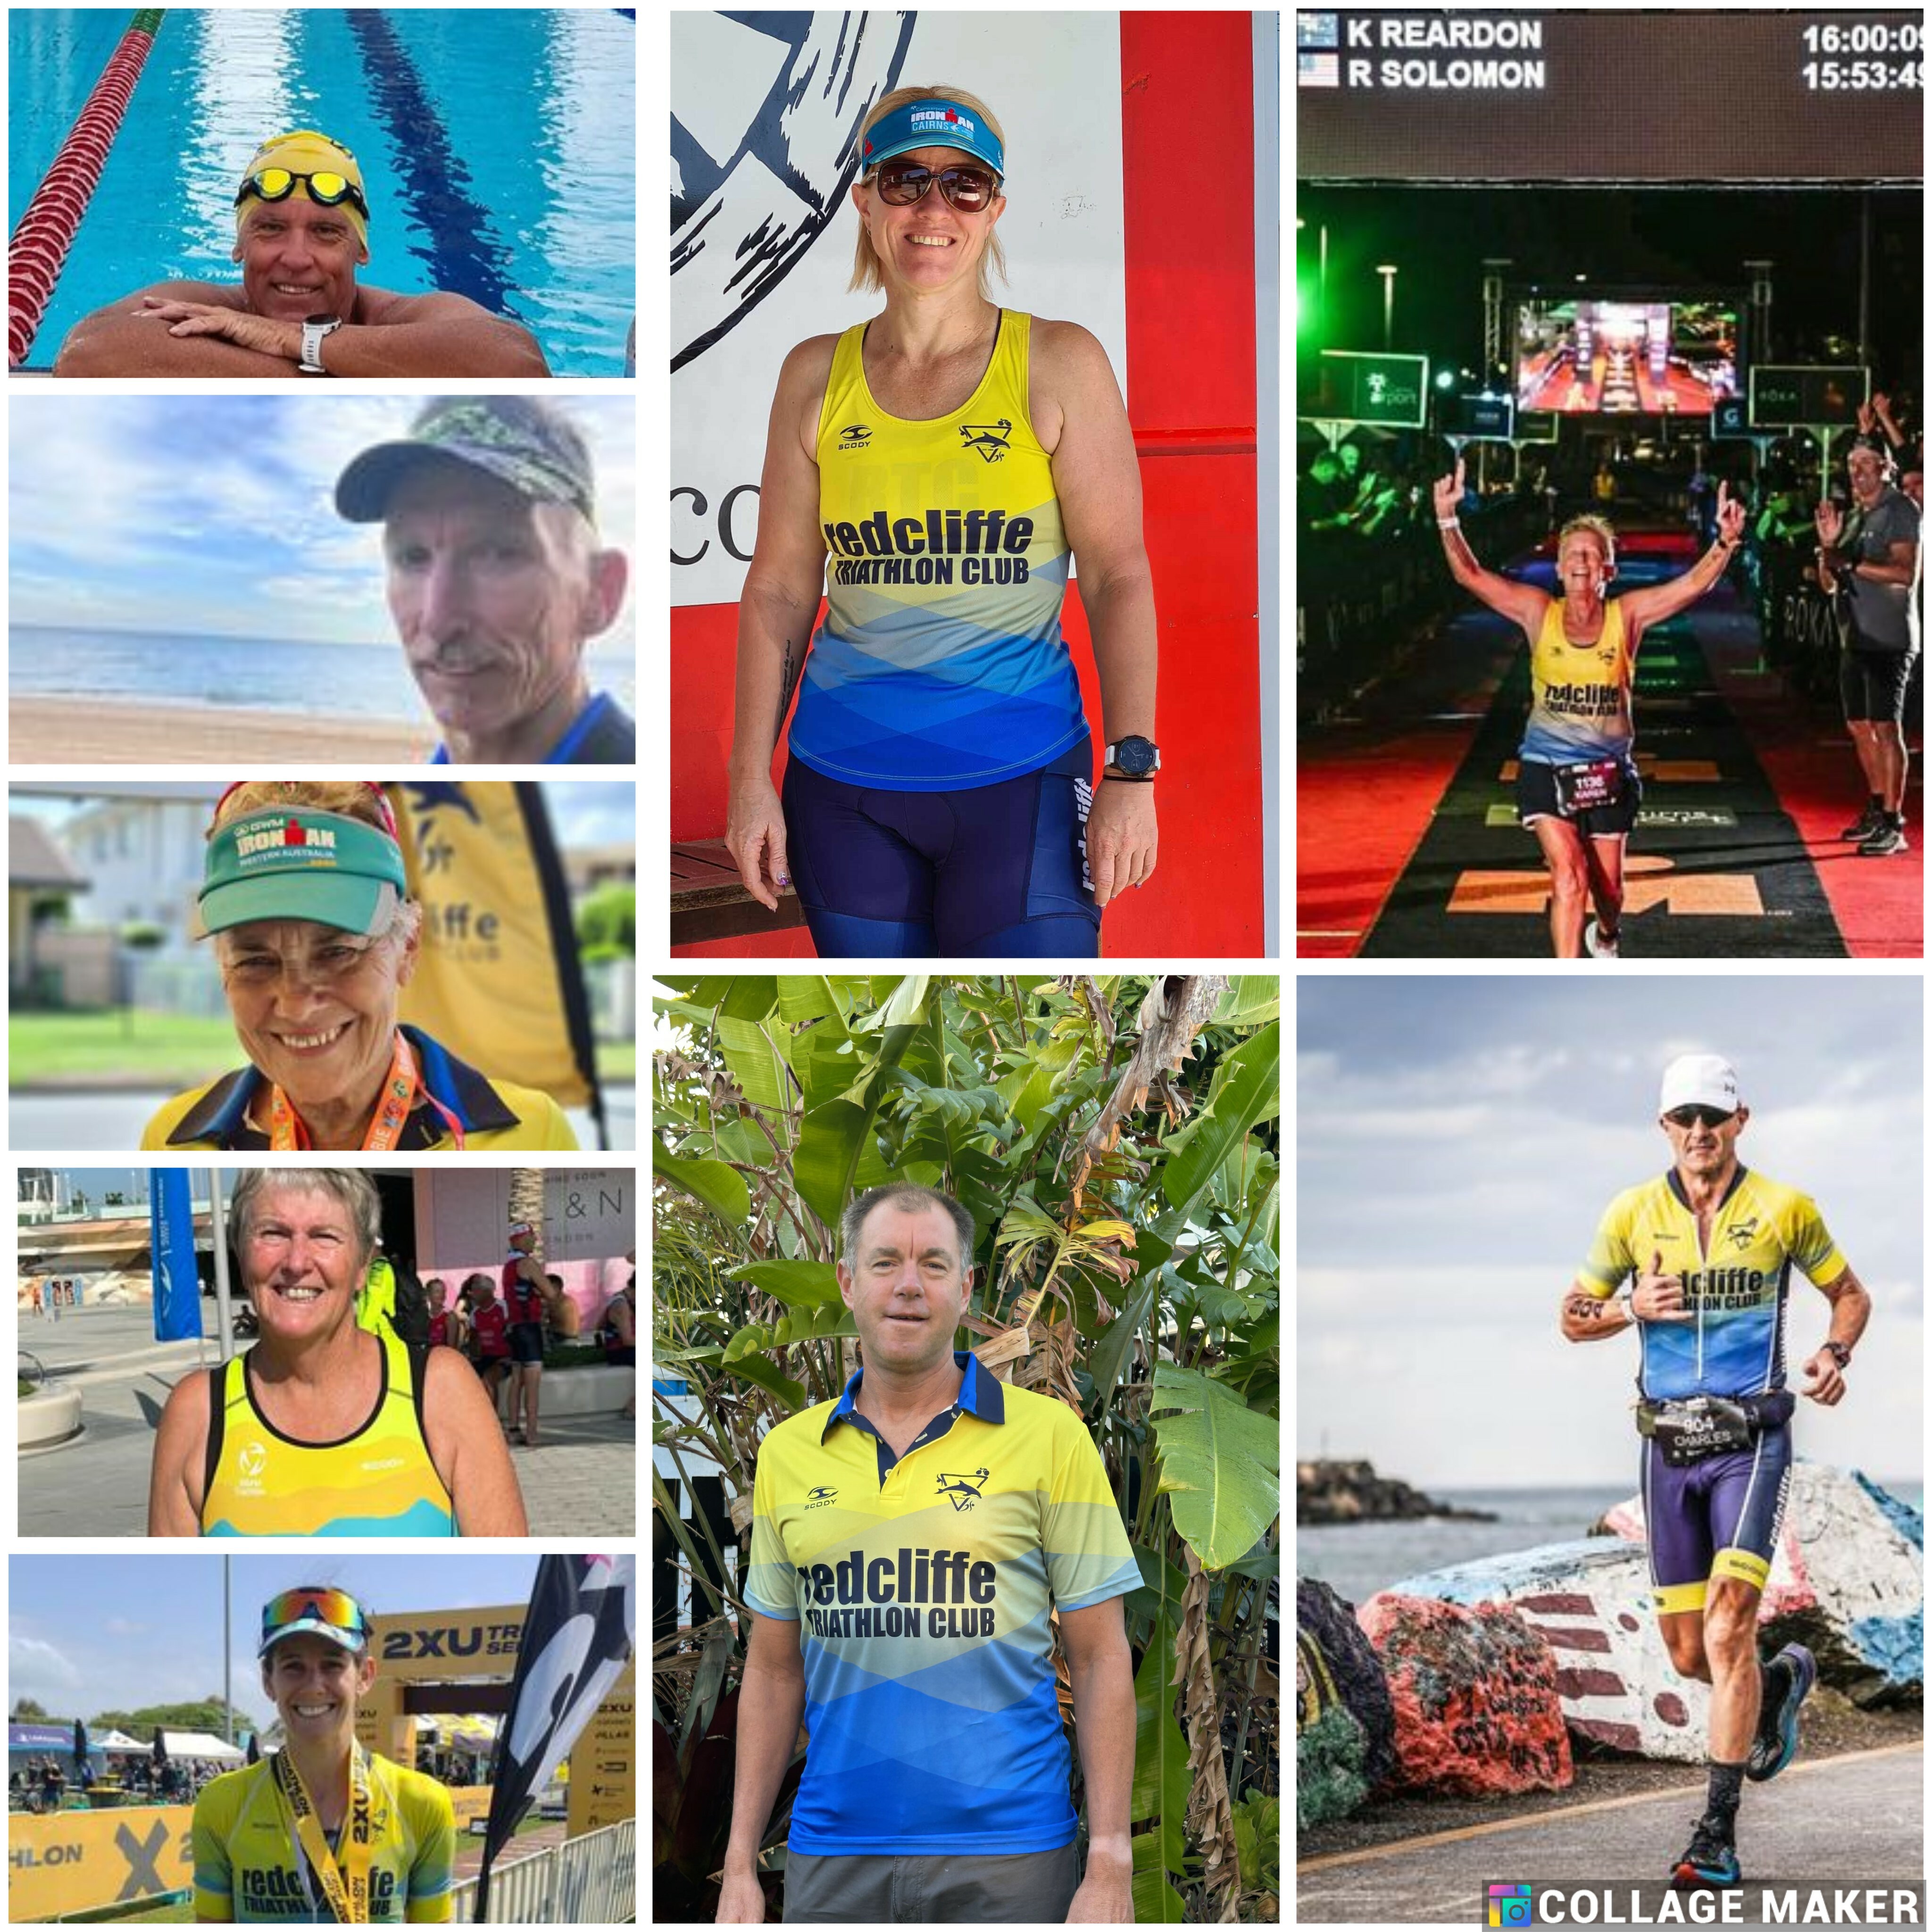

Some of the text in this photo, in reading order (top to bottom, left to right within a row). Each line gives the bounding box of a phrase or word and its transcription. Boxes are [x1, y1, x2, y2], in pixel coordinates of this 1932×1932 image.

[1348, 20, 1542, 48] K REARDON
[1802, 25, 1924, 53] 16:00:0
[1349, 59, 1545, 88] R SOLOMON
[911, 108, 974, 132] IRONMAN
[912, 120, 949, 131] CAIRNS
[838, 441, 872, 450] SCODY
[670, 484, 761, 565] co
[824, 509, 1034, 557] redcliffe
[835, 558, 1029, 585] TRIATHLON CLUB
[600, 1187, 621, 1217] N
[1674, 1430, 1732, 1447] CHARLES
[805, 1499, 837, 1510] SCODY
[797, 1548, 996, 1605] redcliffe
[806, 1607, 995, 1639] TRIATHLON CLUB
[383, 1626, 483, 1659] 2XU
